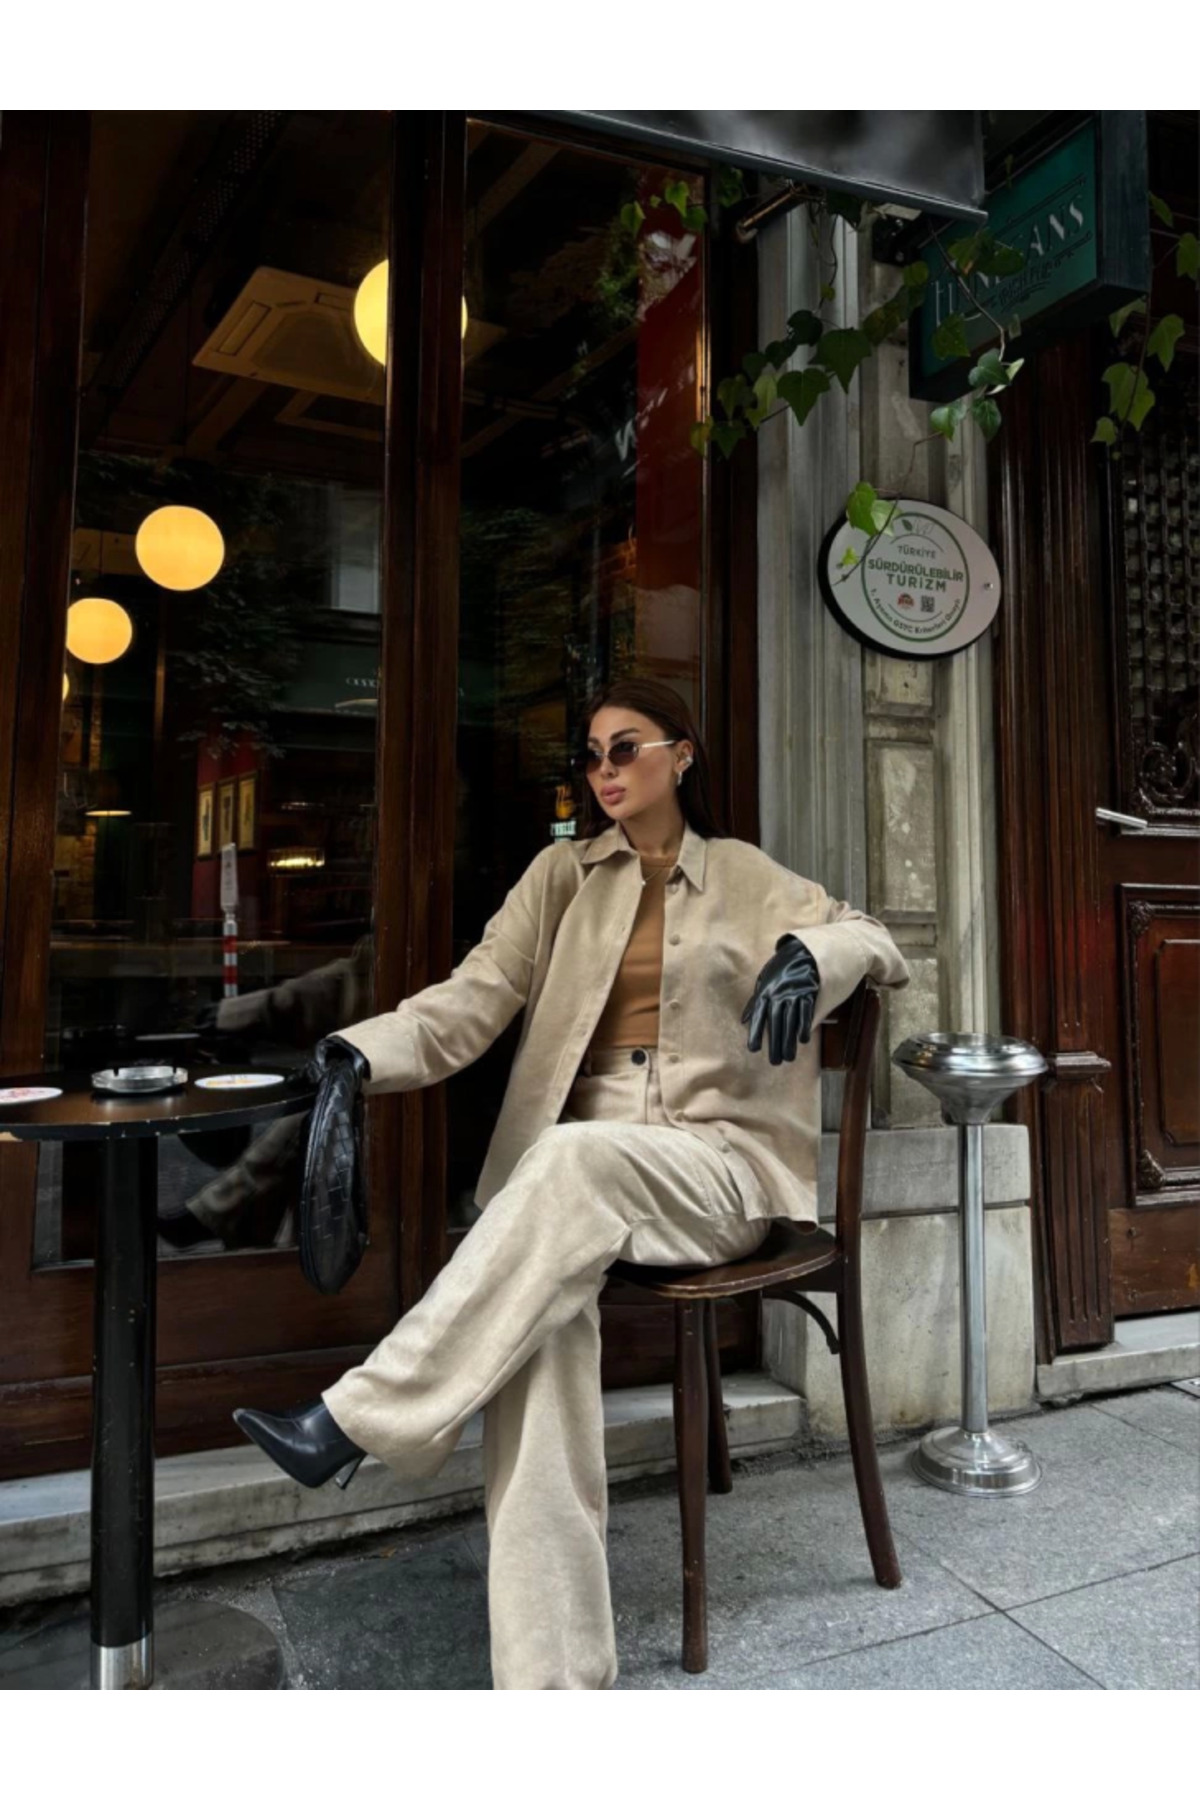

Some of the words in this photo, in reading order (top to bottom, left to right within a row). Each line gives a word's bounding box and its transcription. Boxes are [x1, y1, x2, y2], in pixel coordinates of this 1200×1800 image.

[898, 545, 936, 558] TÜRKİYE
[868, 558, 963, 581] SÜRDÜRÜLEBİLİR
[887, 574, 946, 592] TURİZM
